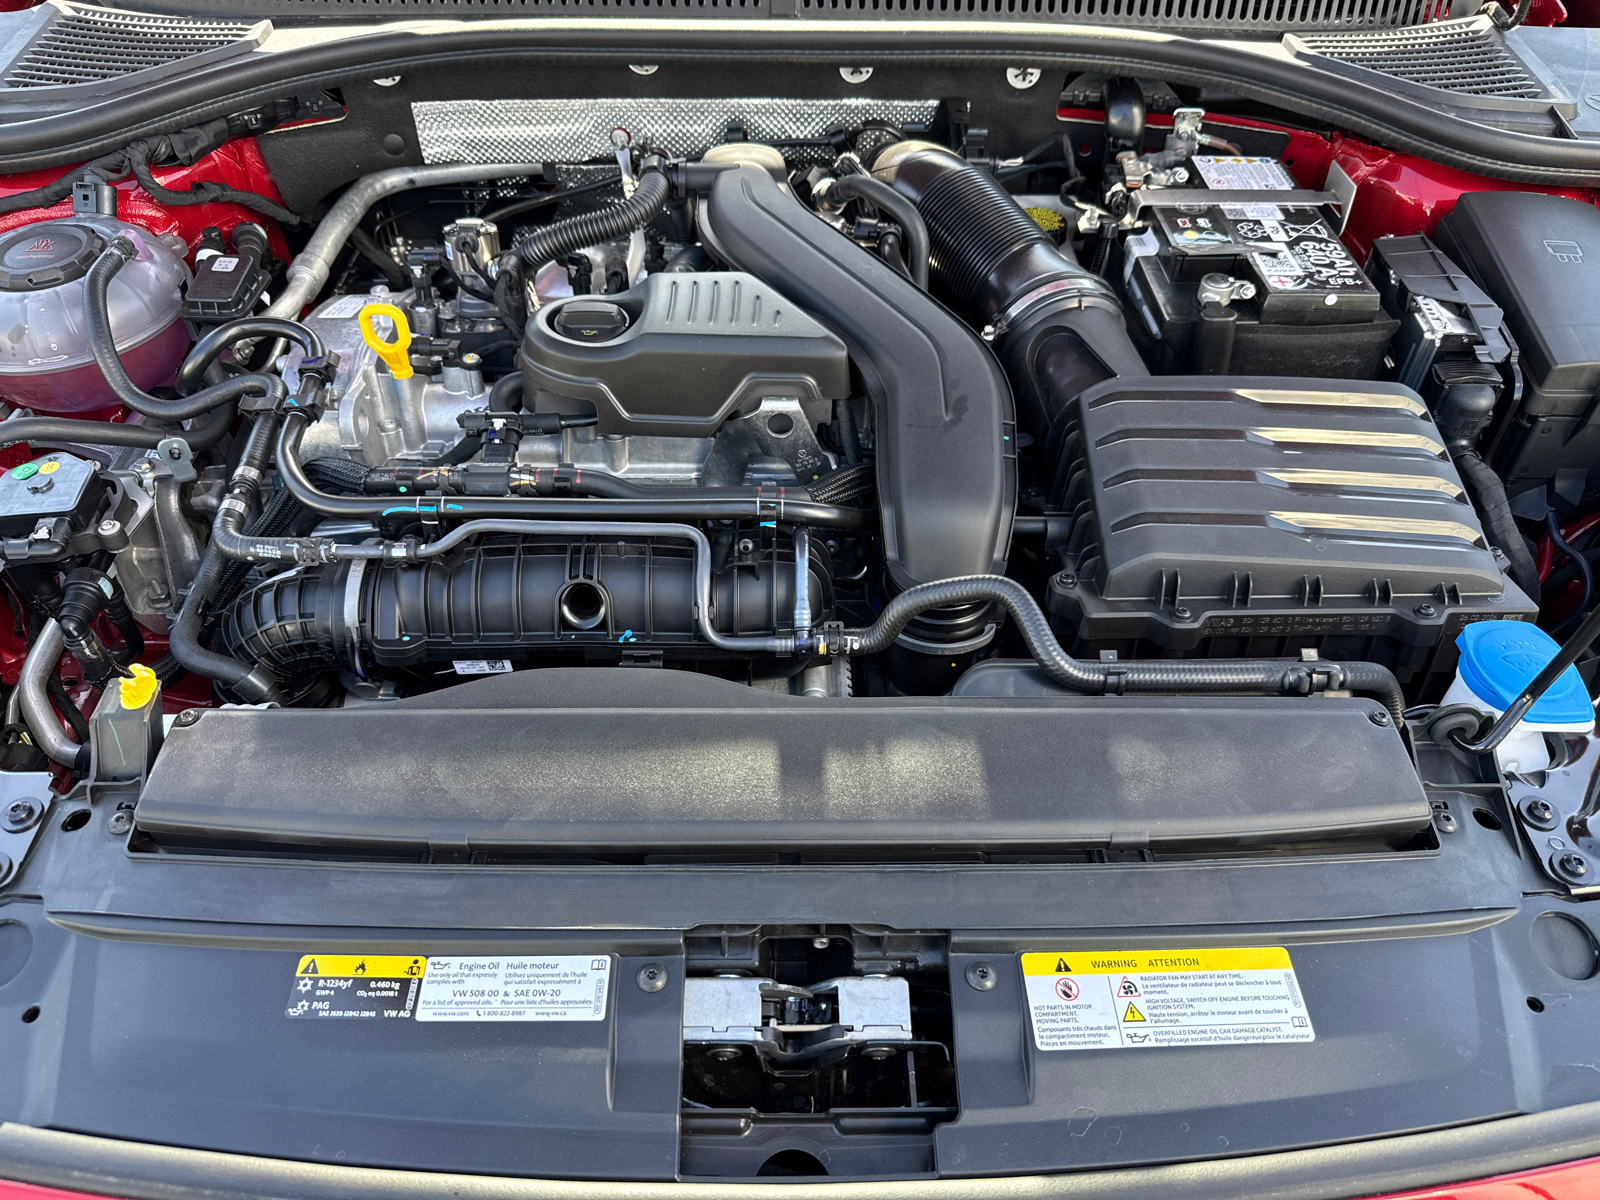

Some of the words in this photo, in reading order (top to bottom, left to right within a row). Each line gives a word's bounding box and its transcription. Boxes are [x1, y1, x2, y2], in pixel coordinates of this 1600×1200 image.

[1300, 241, 1330, 264] 640
[1316, 266, 1338, 277] A
[1320, 242, 1357, 276] 59Ah
[459, 962, 486, 972] Engine
[1091, 960, 1138, 968] WARNING
[1148, 958, 1200, 967] ATTENTION
[318, 979, 353, 990] R-1234yf
[391, 981, 400, 990] kg
